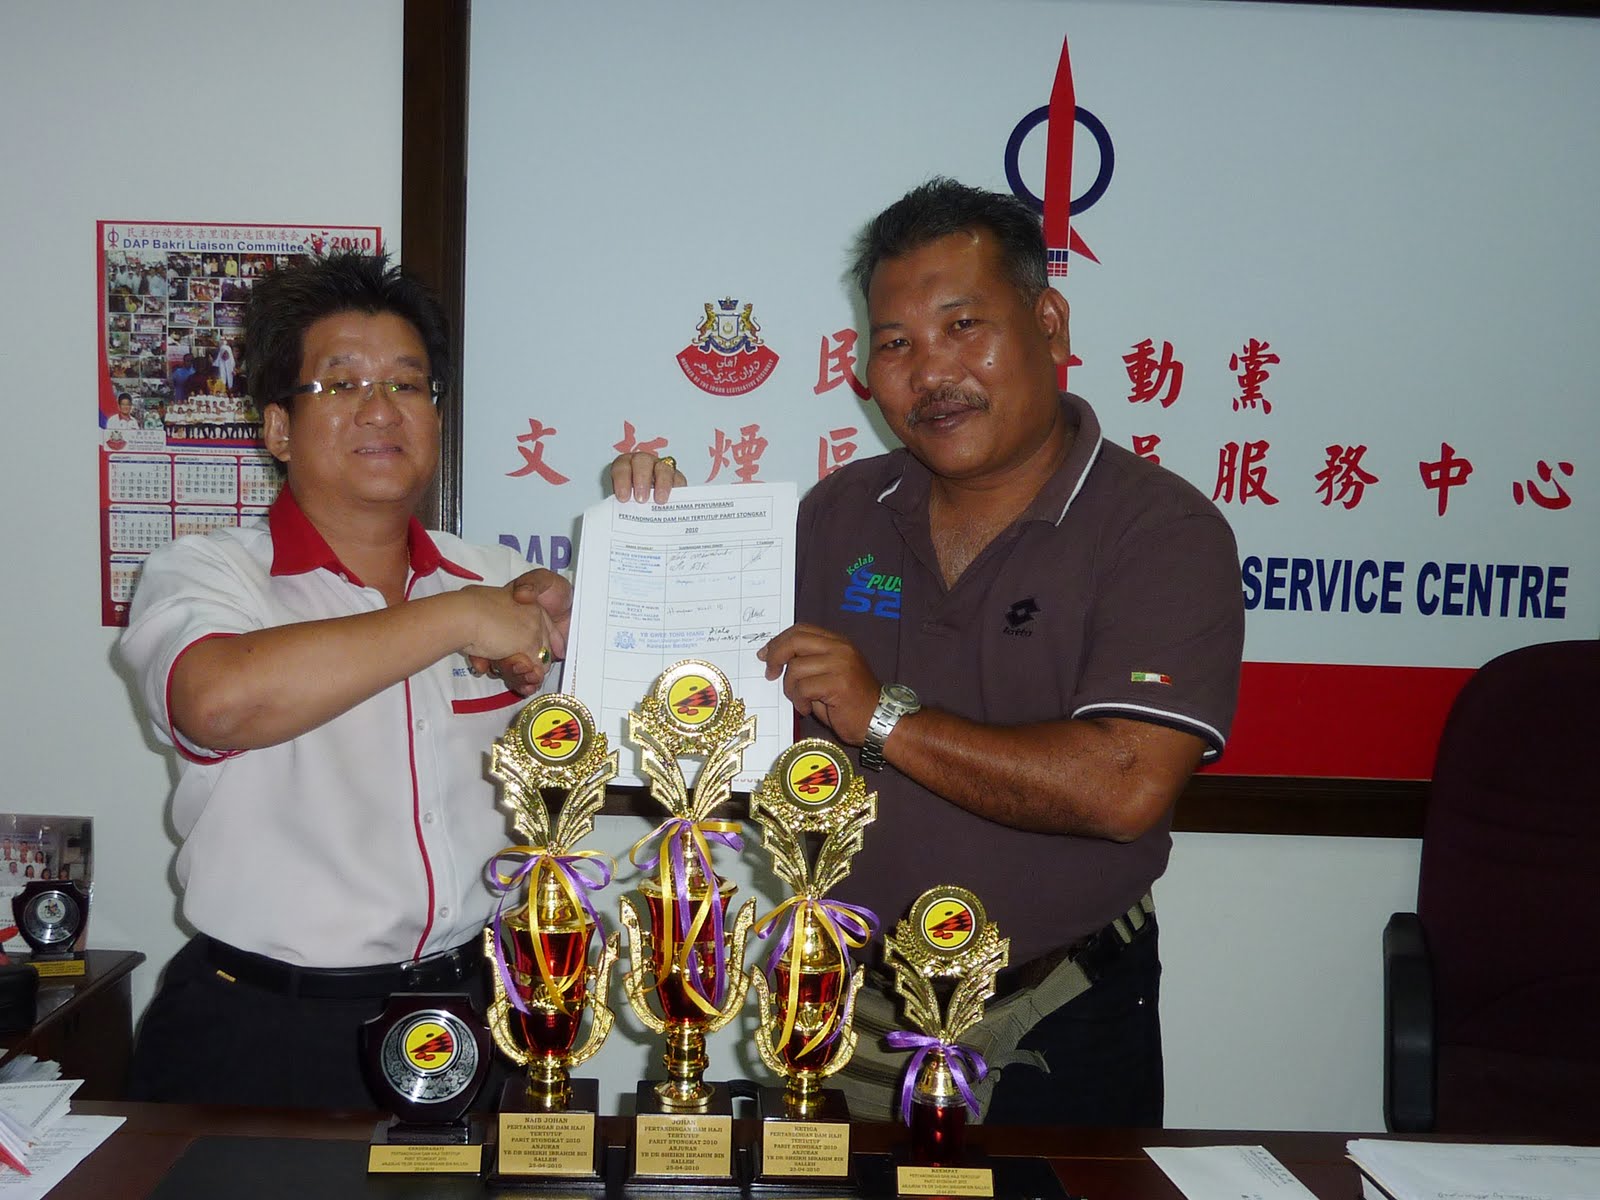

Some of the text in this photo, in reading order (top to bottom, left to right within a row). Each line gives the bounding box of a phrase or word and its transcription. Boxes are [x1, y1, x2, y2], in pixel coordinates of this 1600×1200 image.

[123, 238, 304, 252] DAP Bakri Liaison Committee
[331, 236, 371, 250] 2010
[652, 504, 675, 512] SENARAI
[694, 501, 734, 510] PENYUMBANG
[618, 514, 662, 522] PERTANDINGAN
[846, 554, 874, 575] Kelab
[1241, 555, 1405, 614] SERVICE
[1416, 561, 1570, 619] CENTRE
